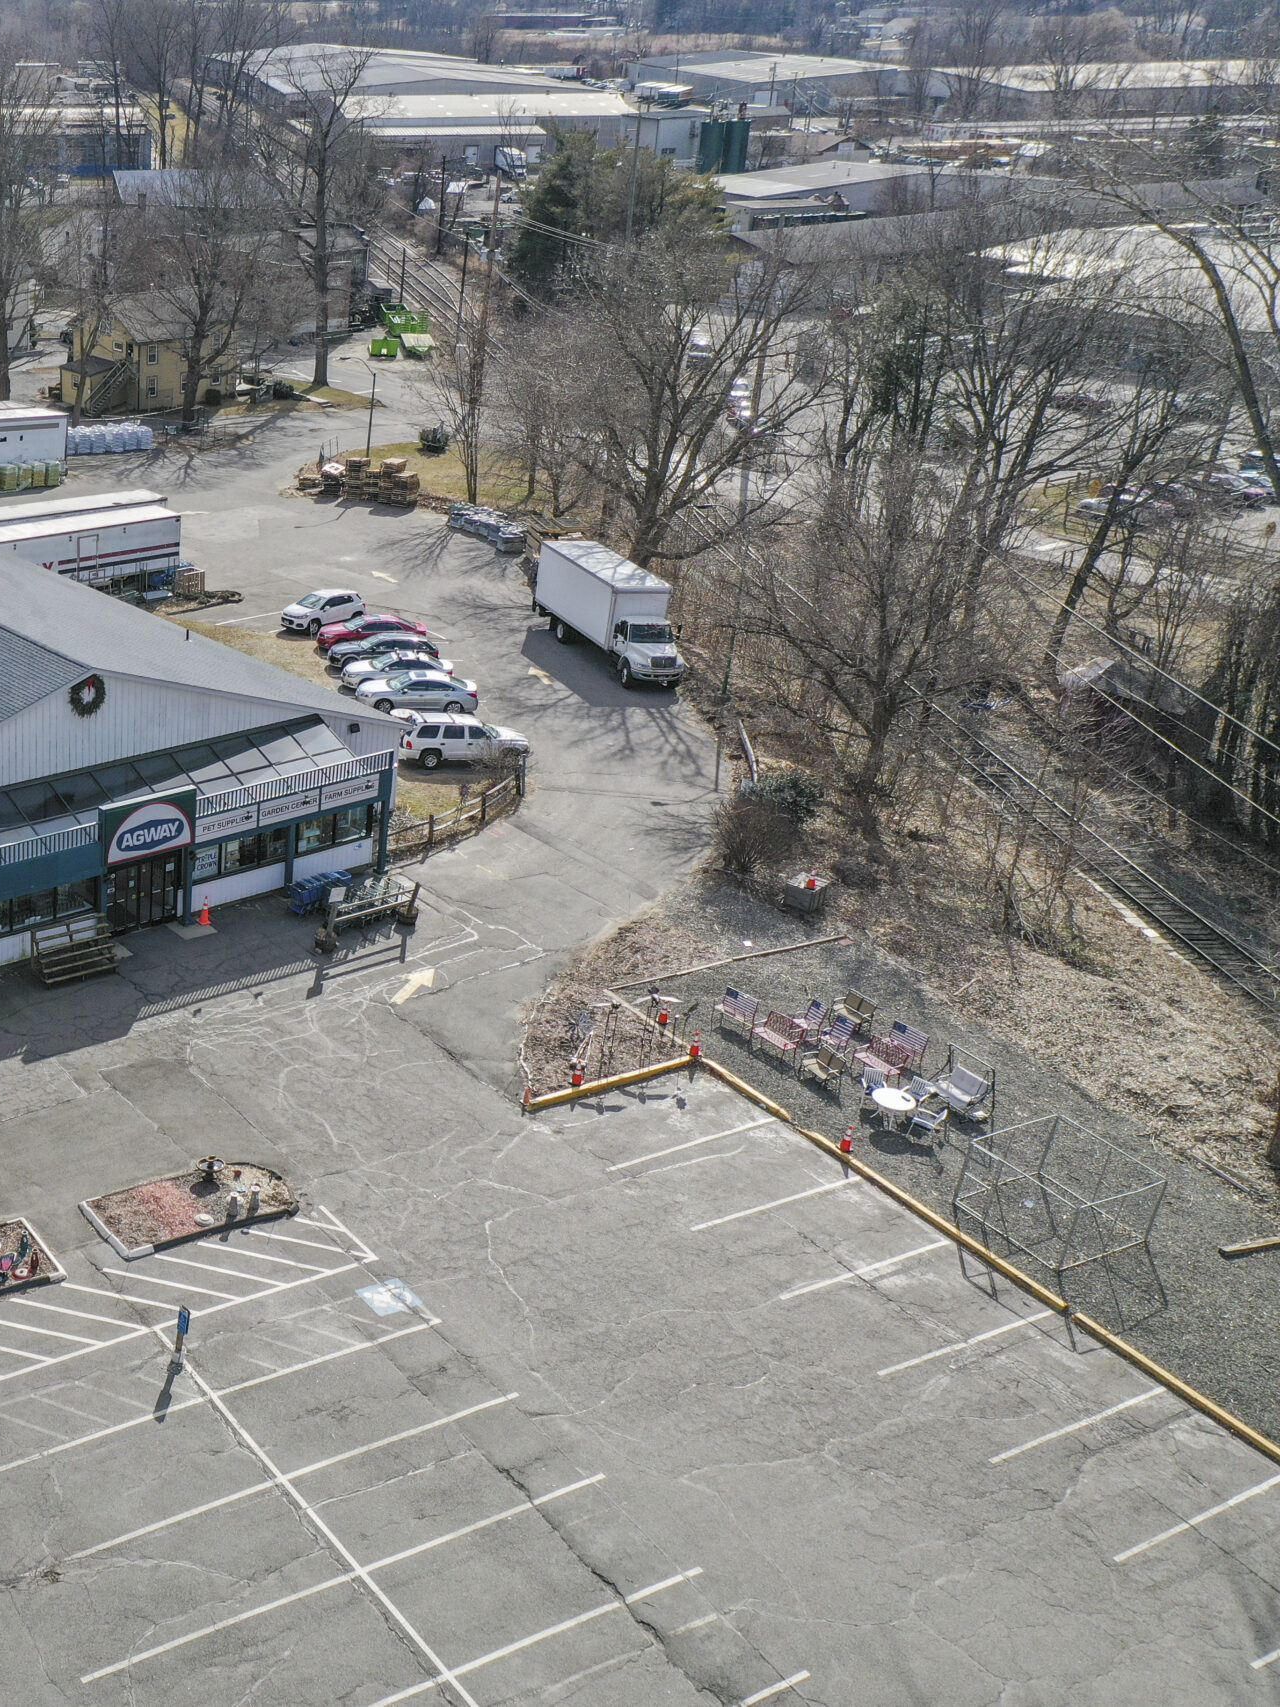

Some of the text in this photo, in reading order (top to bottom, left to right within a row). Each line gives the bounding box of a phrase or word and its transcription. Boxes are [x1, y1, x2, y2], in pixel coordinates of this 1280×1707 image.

[324, 782, 375, 801] FARM SUPPLS
[261, 803, 290, 818] GARDEN
[202, 814, 250, 833] PET SUPPLIE
[121, 821, 180, 849] AGWAY
[197, 860, 217, 871] CROWN
